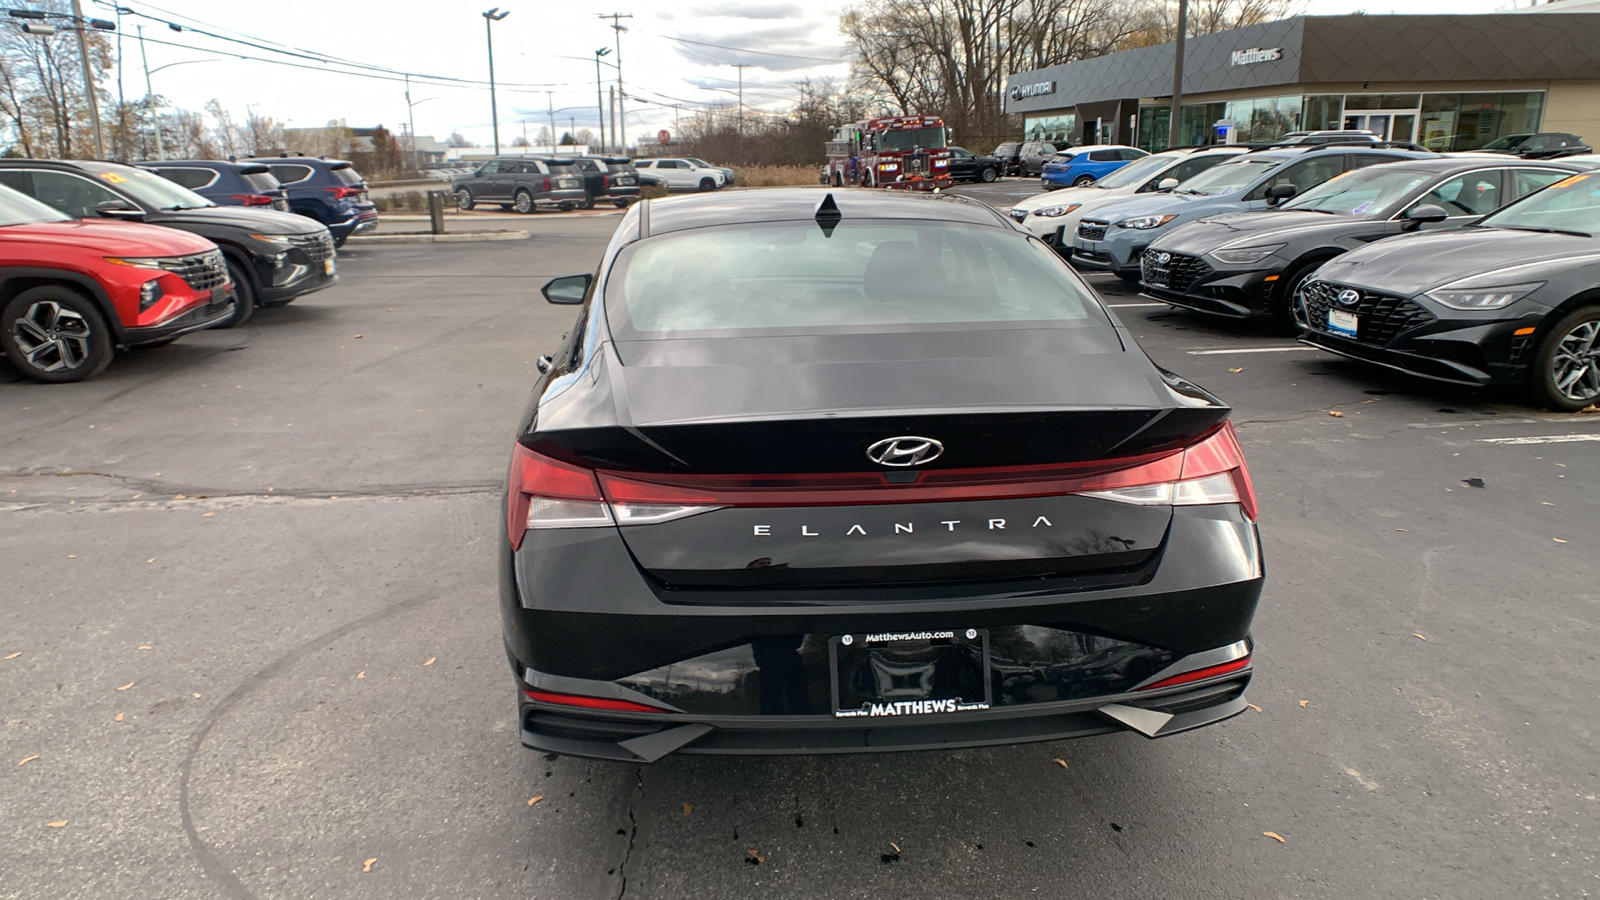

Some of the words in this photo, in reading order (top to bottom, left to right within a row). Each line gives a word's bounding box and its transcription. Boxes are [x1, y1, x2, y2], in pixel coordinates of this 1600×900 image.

[1231, 47, 1281, 66] Matthews
[1021, 80, 1053, 98] HYUNDAI
[753, 516, 1052, 536] ELANTRA
[865, 631, 954, 643] MatthewsAuto.com
[870, 699, 956, 717] MATTHEWS
